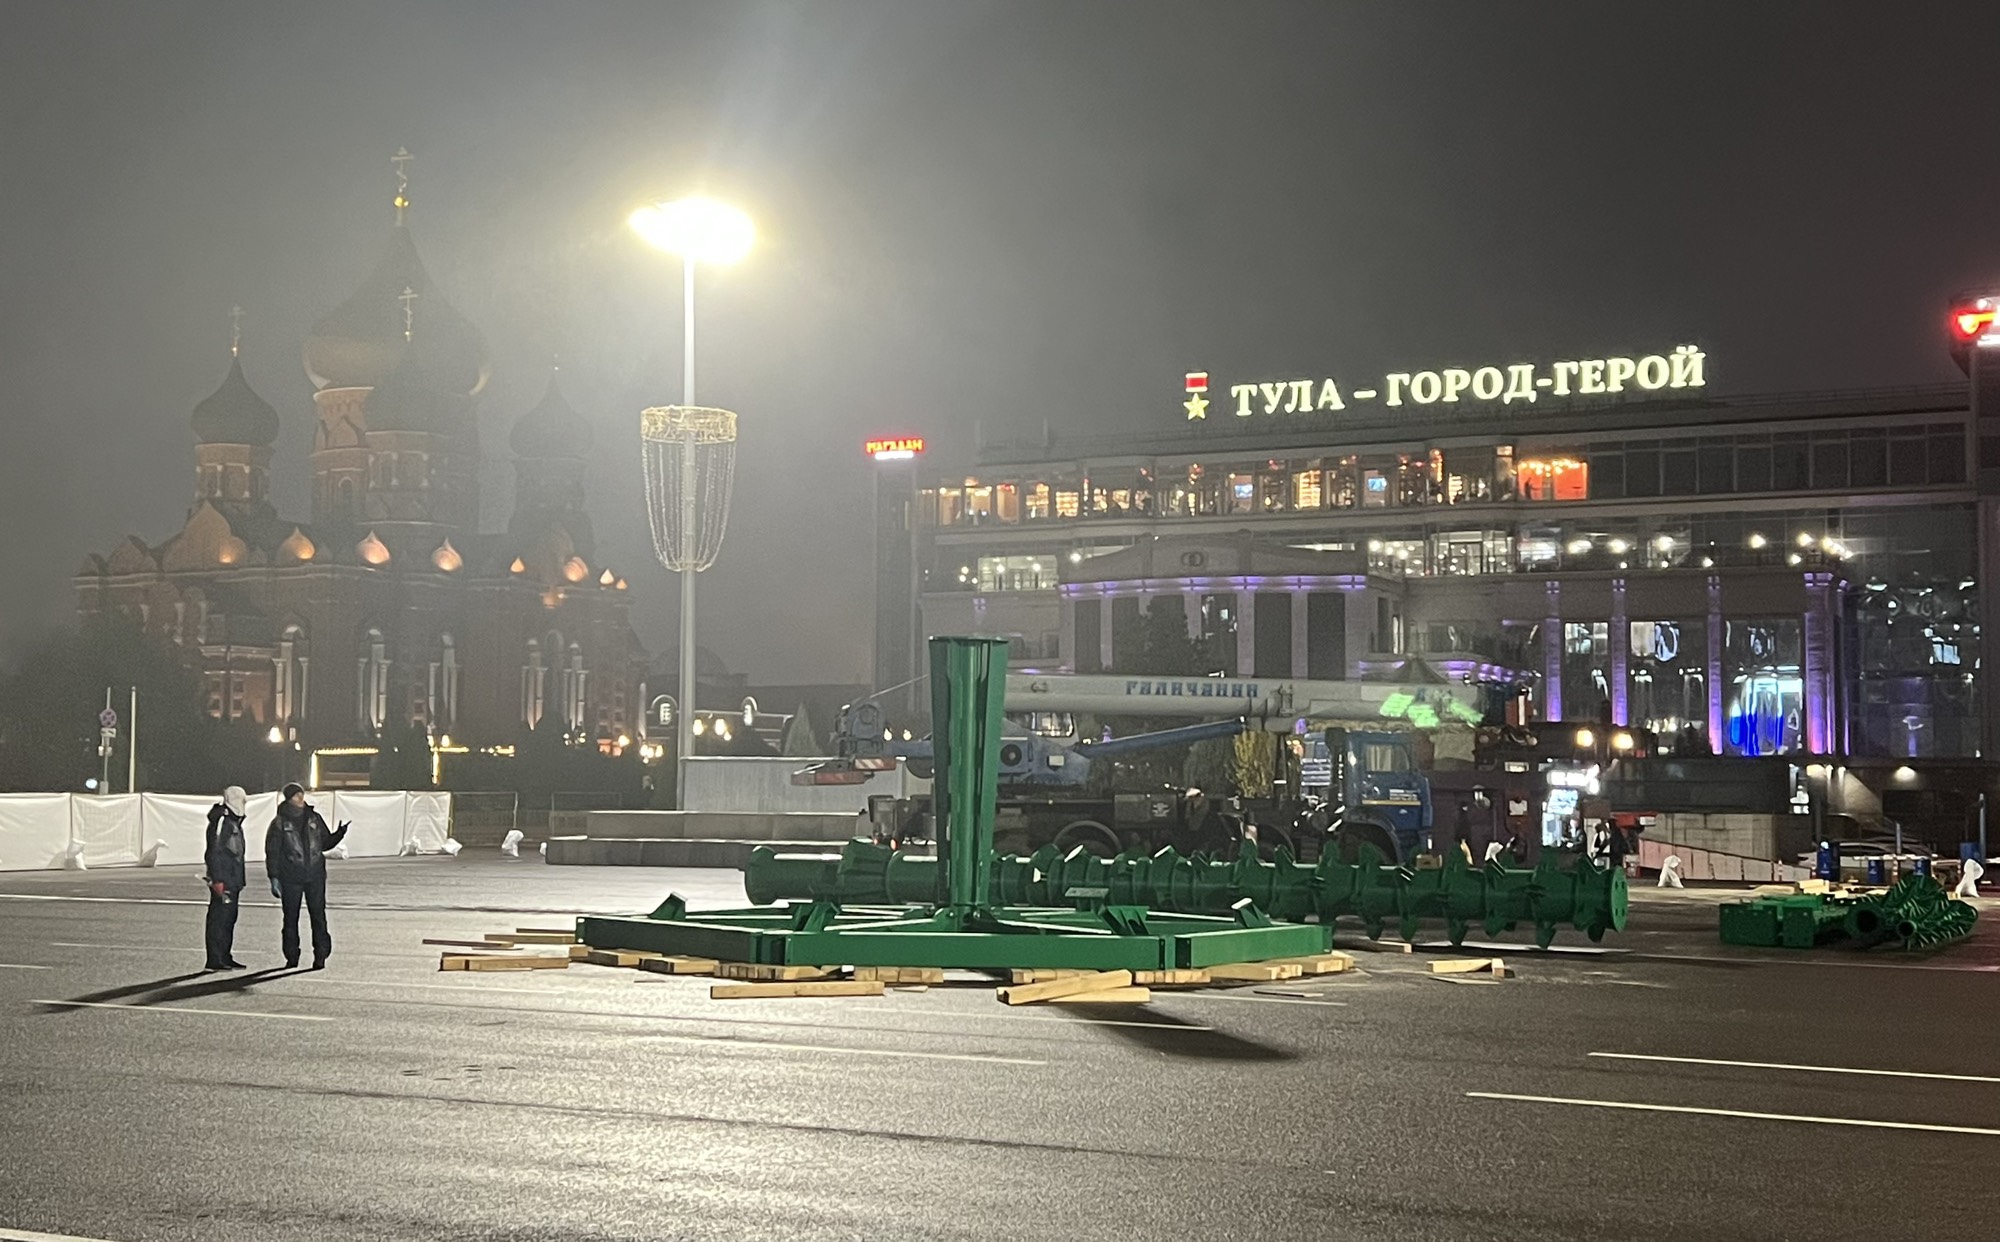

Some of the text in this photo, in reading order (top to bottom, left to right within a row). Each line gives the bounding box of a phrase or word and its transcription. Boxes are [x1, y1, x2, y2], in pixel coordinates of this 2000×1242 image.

[1231, 378, 1345, 416] ТУЛА
[1386, 345, 1706, 406] ГОРОД-ГЕРОЙ
[1126, 681, 1258, 698] ГАЛИЧАНИН
